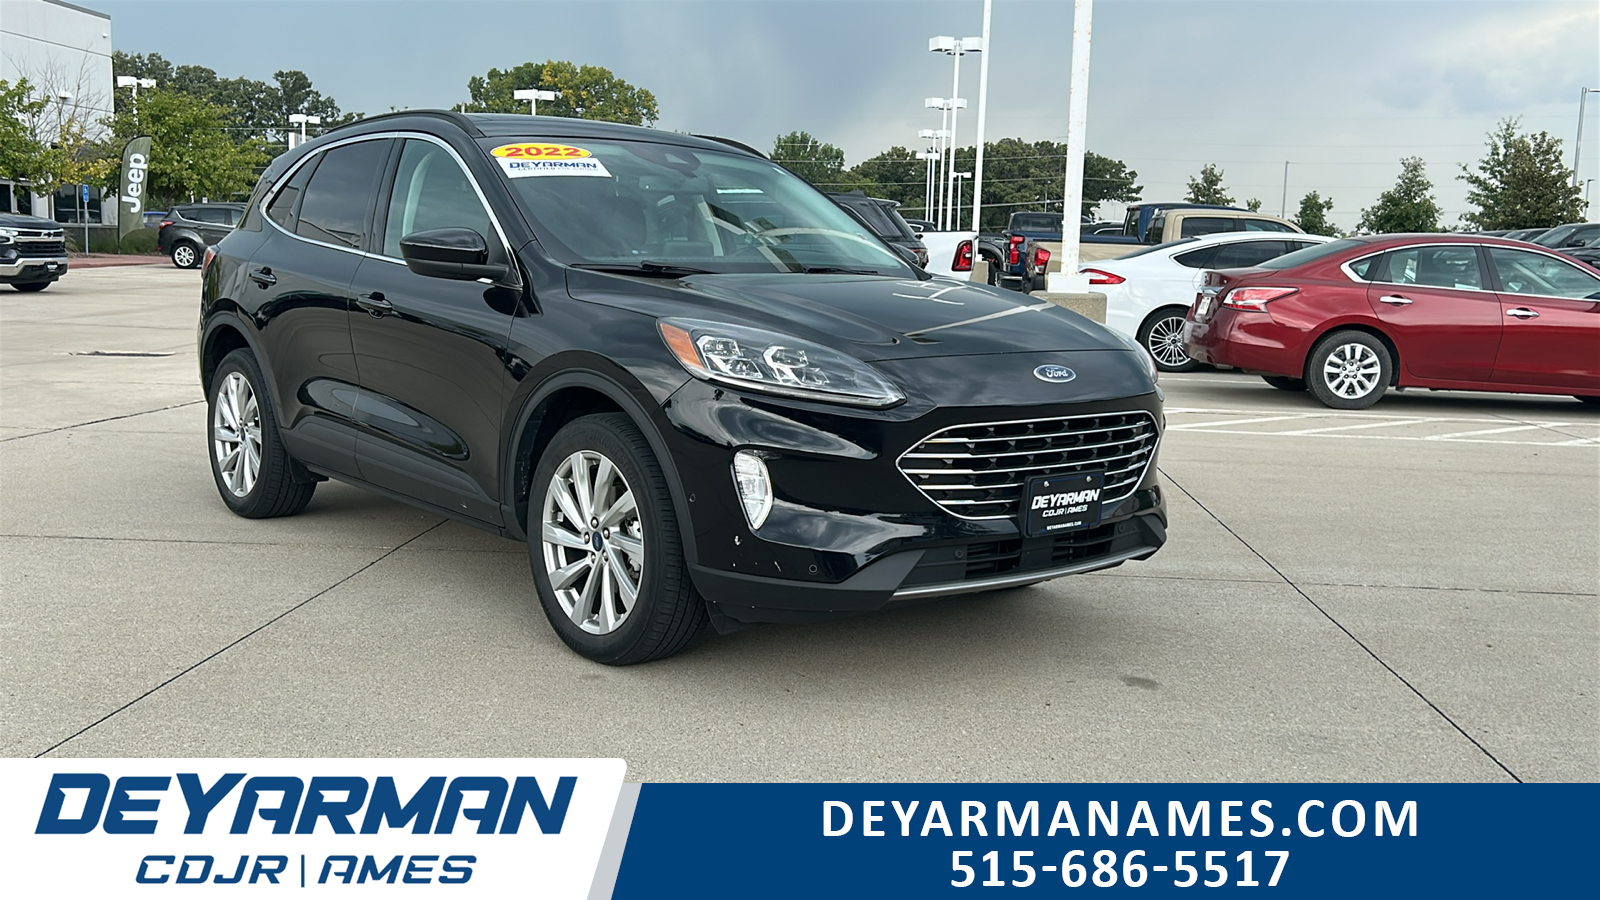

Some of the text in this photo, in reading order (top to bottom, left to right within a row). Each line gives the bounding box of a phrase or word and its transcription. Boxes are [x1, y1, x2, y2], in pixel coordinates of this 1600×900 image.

[504, 146, 582, 157] 2022
[509, 161, 597, 169] DEYARMAN
[121, 153, 148, 214] Jeep
[1045, 367, 1069, 378] Ford
[1031, 488, 1101, 510] DEYARMAN
[1042, 504, 1088, 518] CDJR AMES
